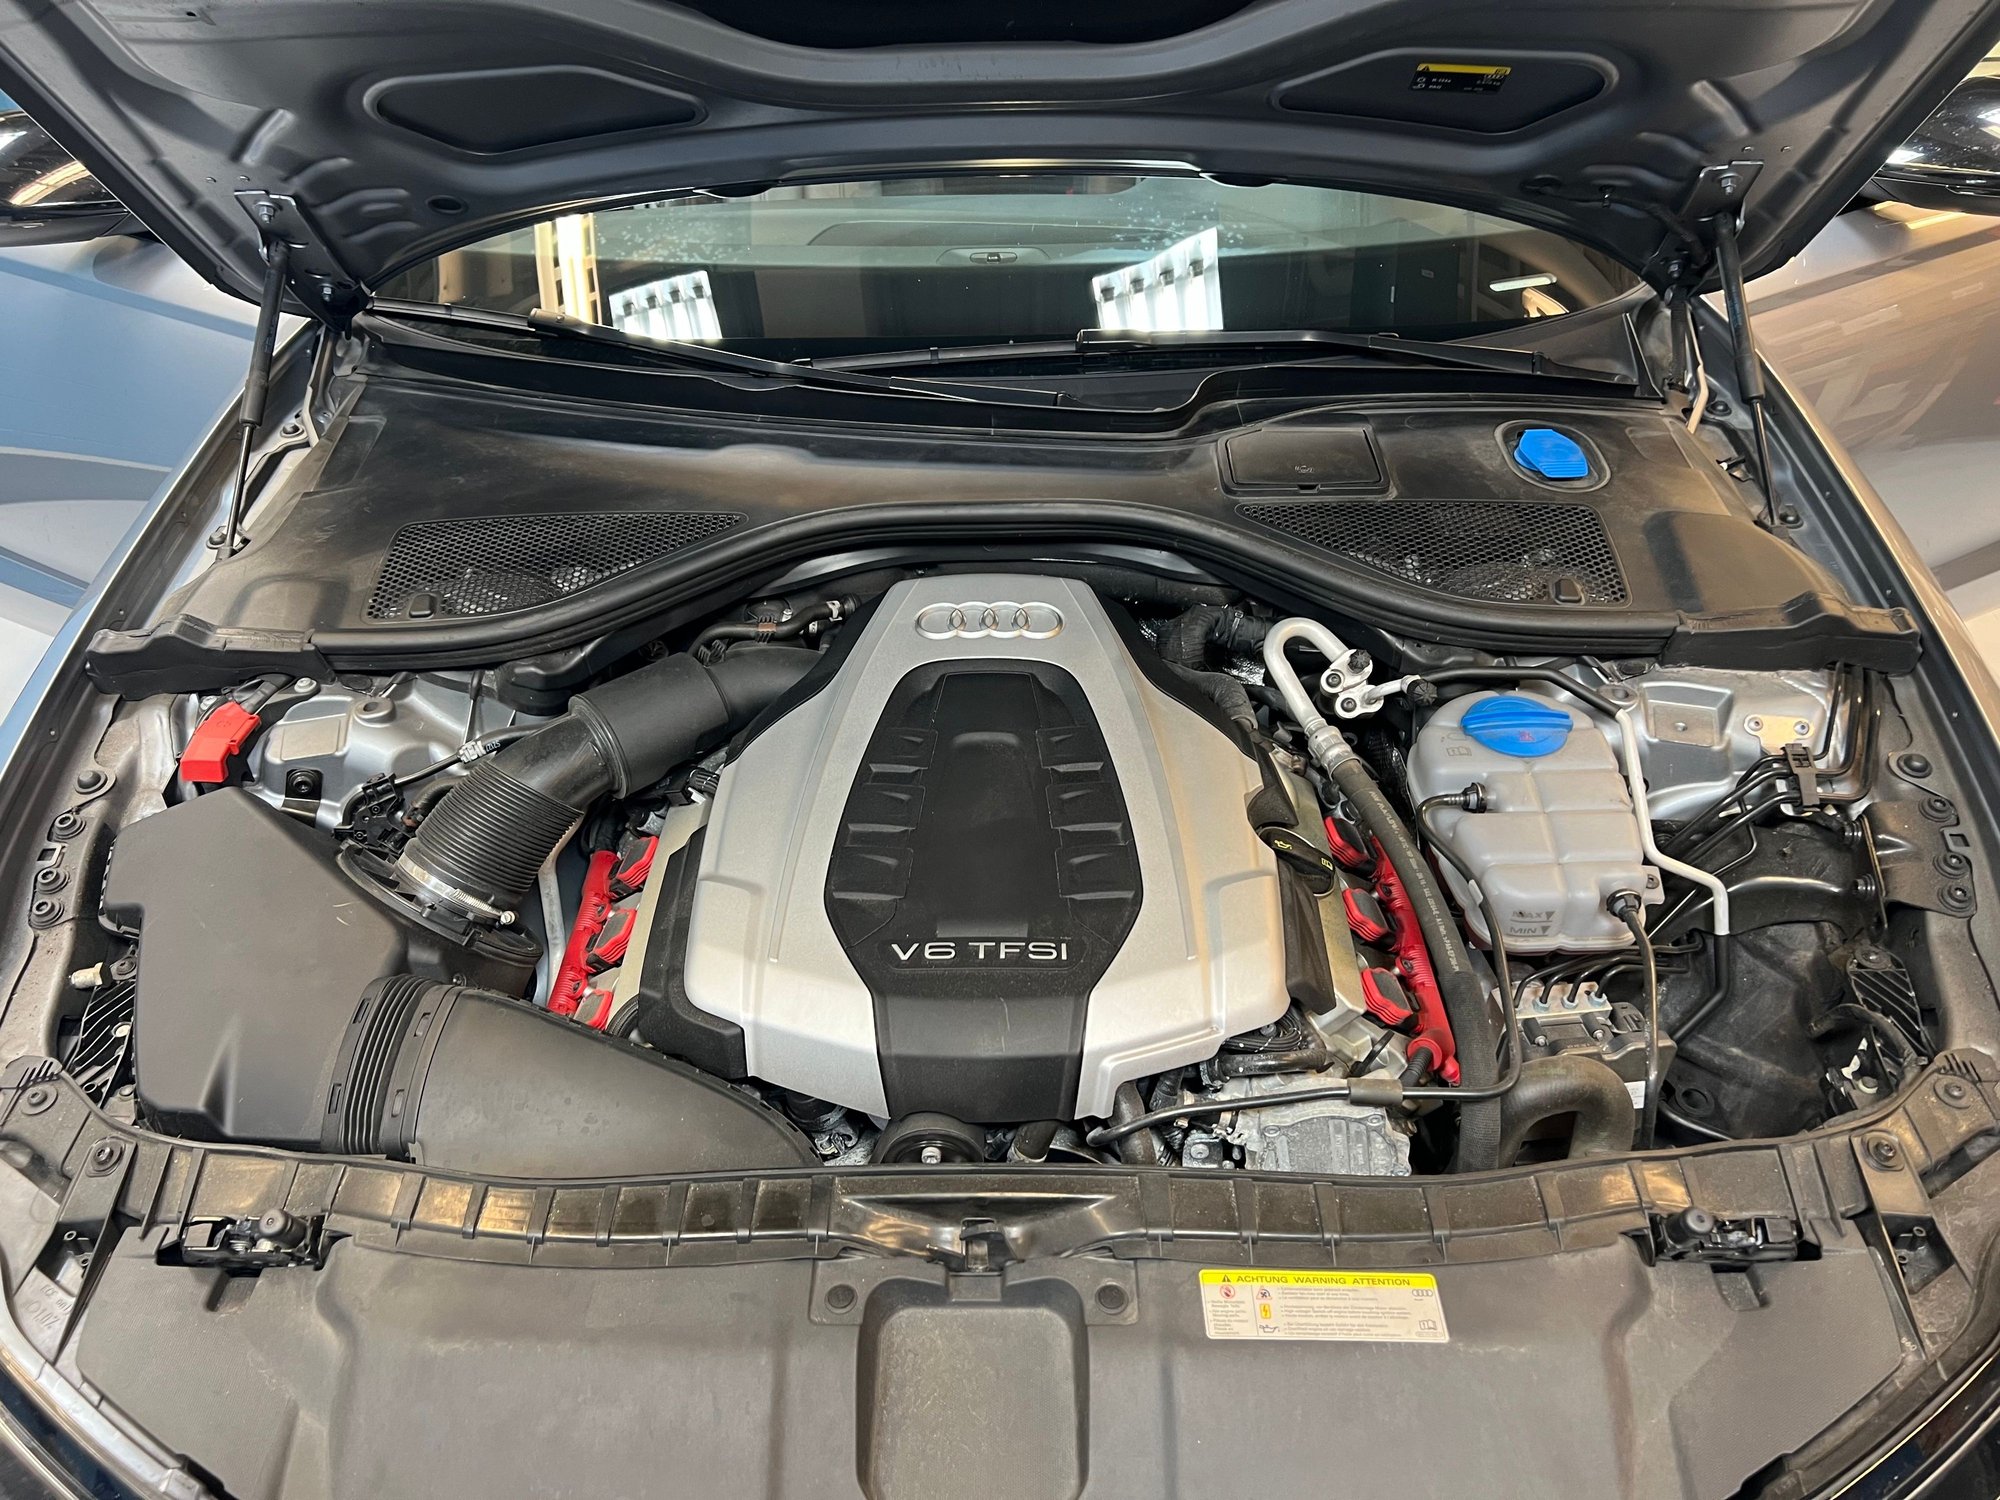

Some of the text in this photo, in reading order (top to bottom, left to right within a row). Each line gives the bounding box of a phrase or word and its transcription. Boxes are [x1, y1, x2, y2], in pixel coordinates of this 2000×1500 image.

[1512, 911, 1542, 919] MAX
[1510, 926, 1537, 935] MIN
[891, 941, 1068, 961] V6 TFSI
[1236, 1275, 1411, 1286] ACHTUNG WARNING ATTENTION
